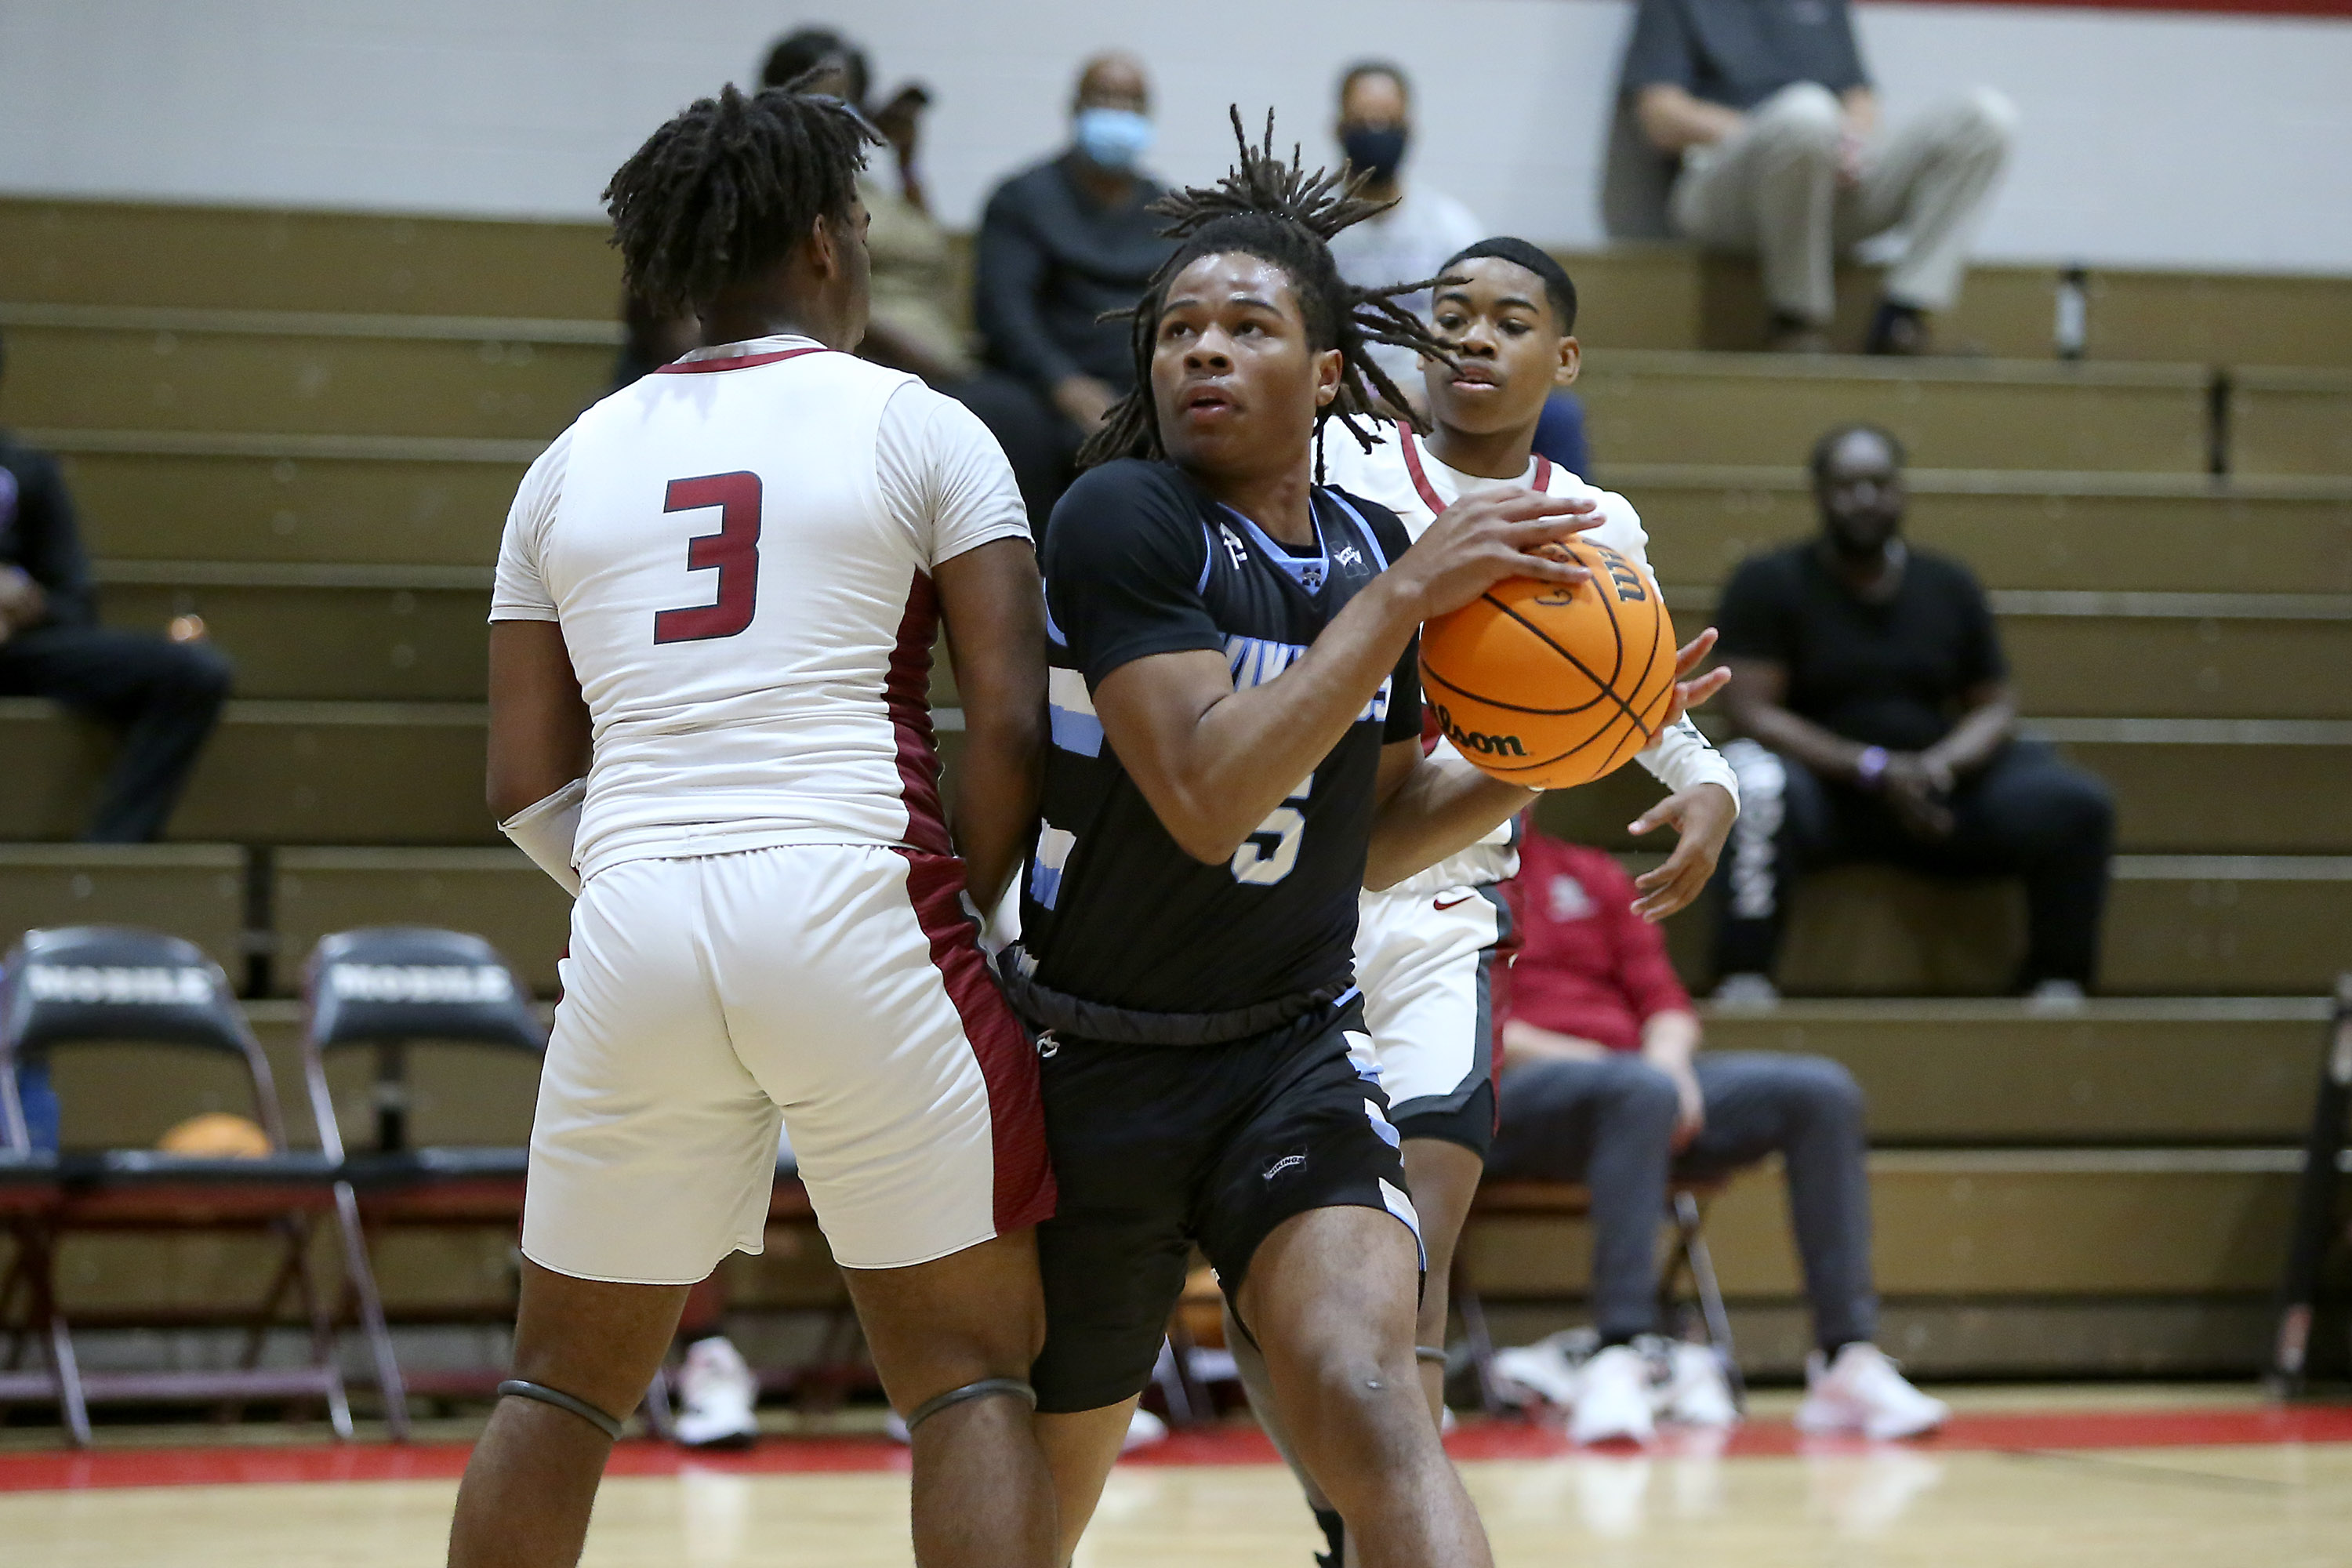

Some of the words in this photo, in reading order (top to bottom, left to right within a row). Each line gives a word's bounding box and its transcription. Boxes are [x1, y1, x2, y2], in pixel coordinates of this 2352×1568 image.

[653, 470, 763, 645] 3
[1429, 699, 1528, 757] lson
[1229, 771, 1315, 886] 5
